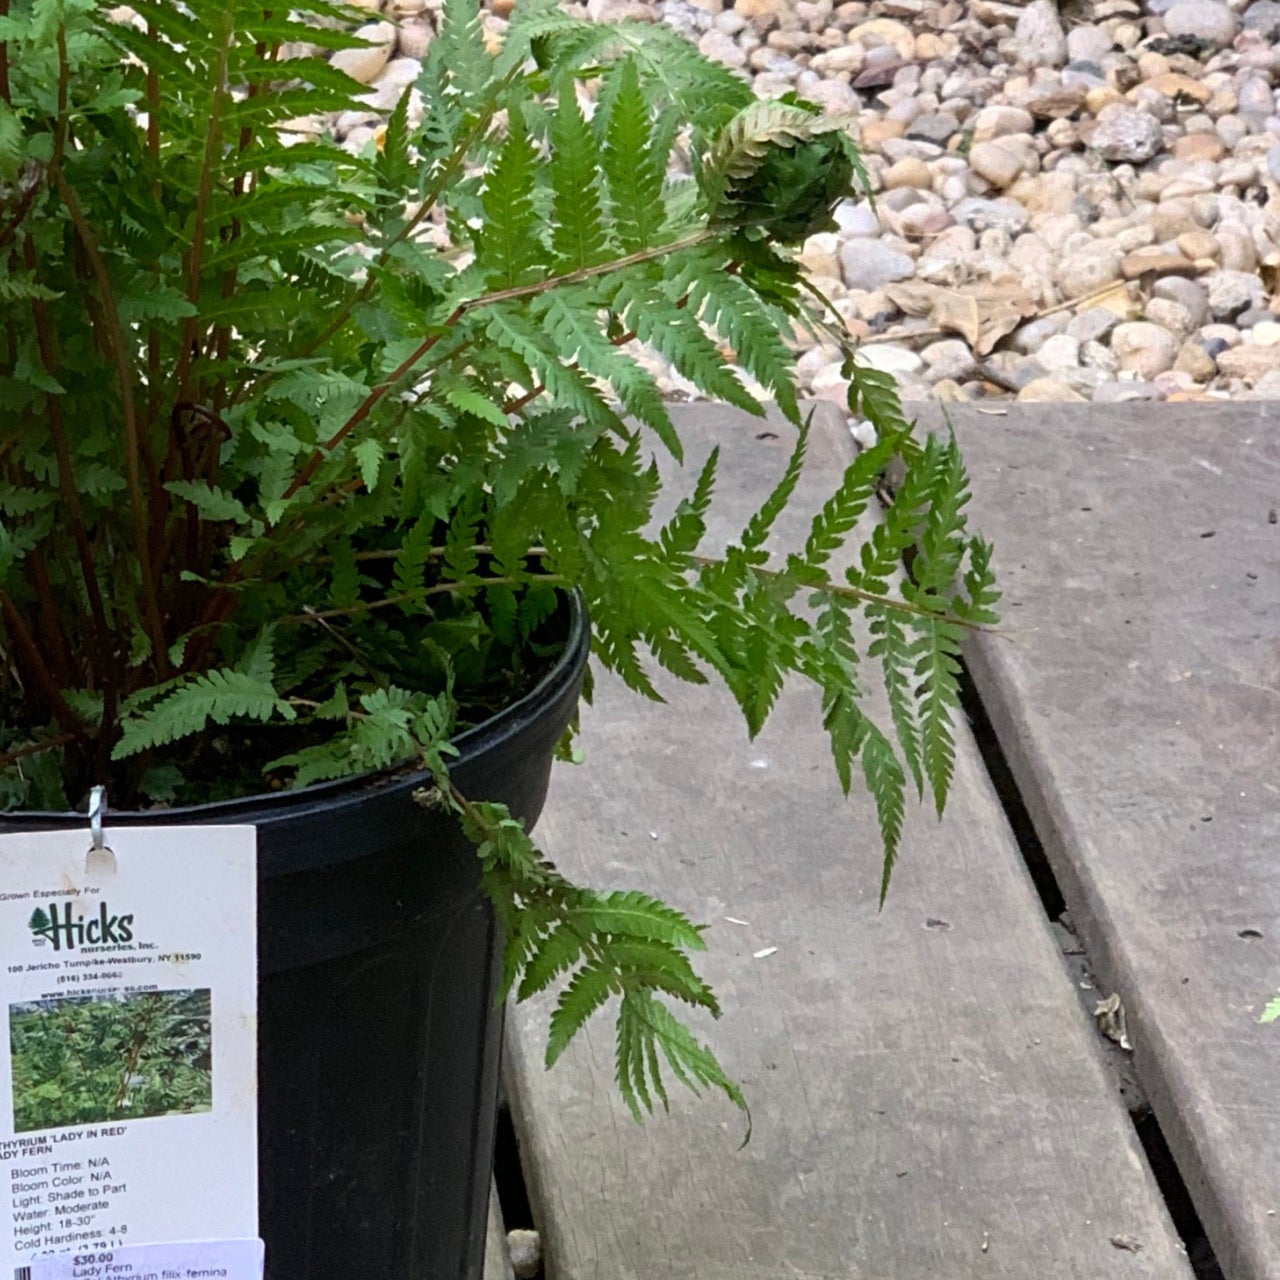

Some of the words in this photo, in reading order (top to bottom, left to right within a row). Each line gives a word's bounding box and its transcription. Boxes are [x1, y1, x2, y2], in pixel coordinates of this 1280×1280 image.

[0, 892, 30, 901] Grown
[33, 888, 81, 899] Especially
[84, 886, 100, 895] For
[33, 901, 134, 951] Hicks
[138, 941, 159, 950] Inc.
[26, 962, 61, 972] Jericho
[158, 955, 171, 963] NY
[174, 952, 202, 962] 11590
[86, 1129, 97, 1139] IN
[22, 1145, 53, 1157] FERN
[11, 1166, 48, 1179] Bloom
[88, 1157, 110, 1168] N/A
[11, 1180, 49, 1194] Bloom
[90, 1171, 112, 1182] N/A
[47, 1189, 85, 1202] Shade
[88, 1187, 100, 1197] to
[103, 1183, 127, 1194] Part
[55, 1200, 109, 1215] Moderate
[14, 1239, 41, 1251] Cold
[109, 1224, 128, 1235] 4-8
[73, 1253, 114, 1266] $30.00
[73, 1265, 102, 1278] Lady
[105, 1263, 132, 1274] Fern
